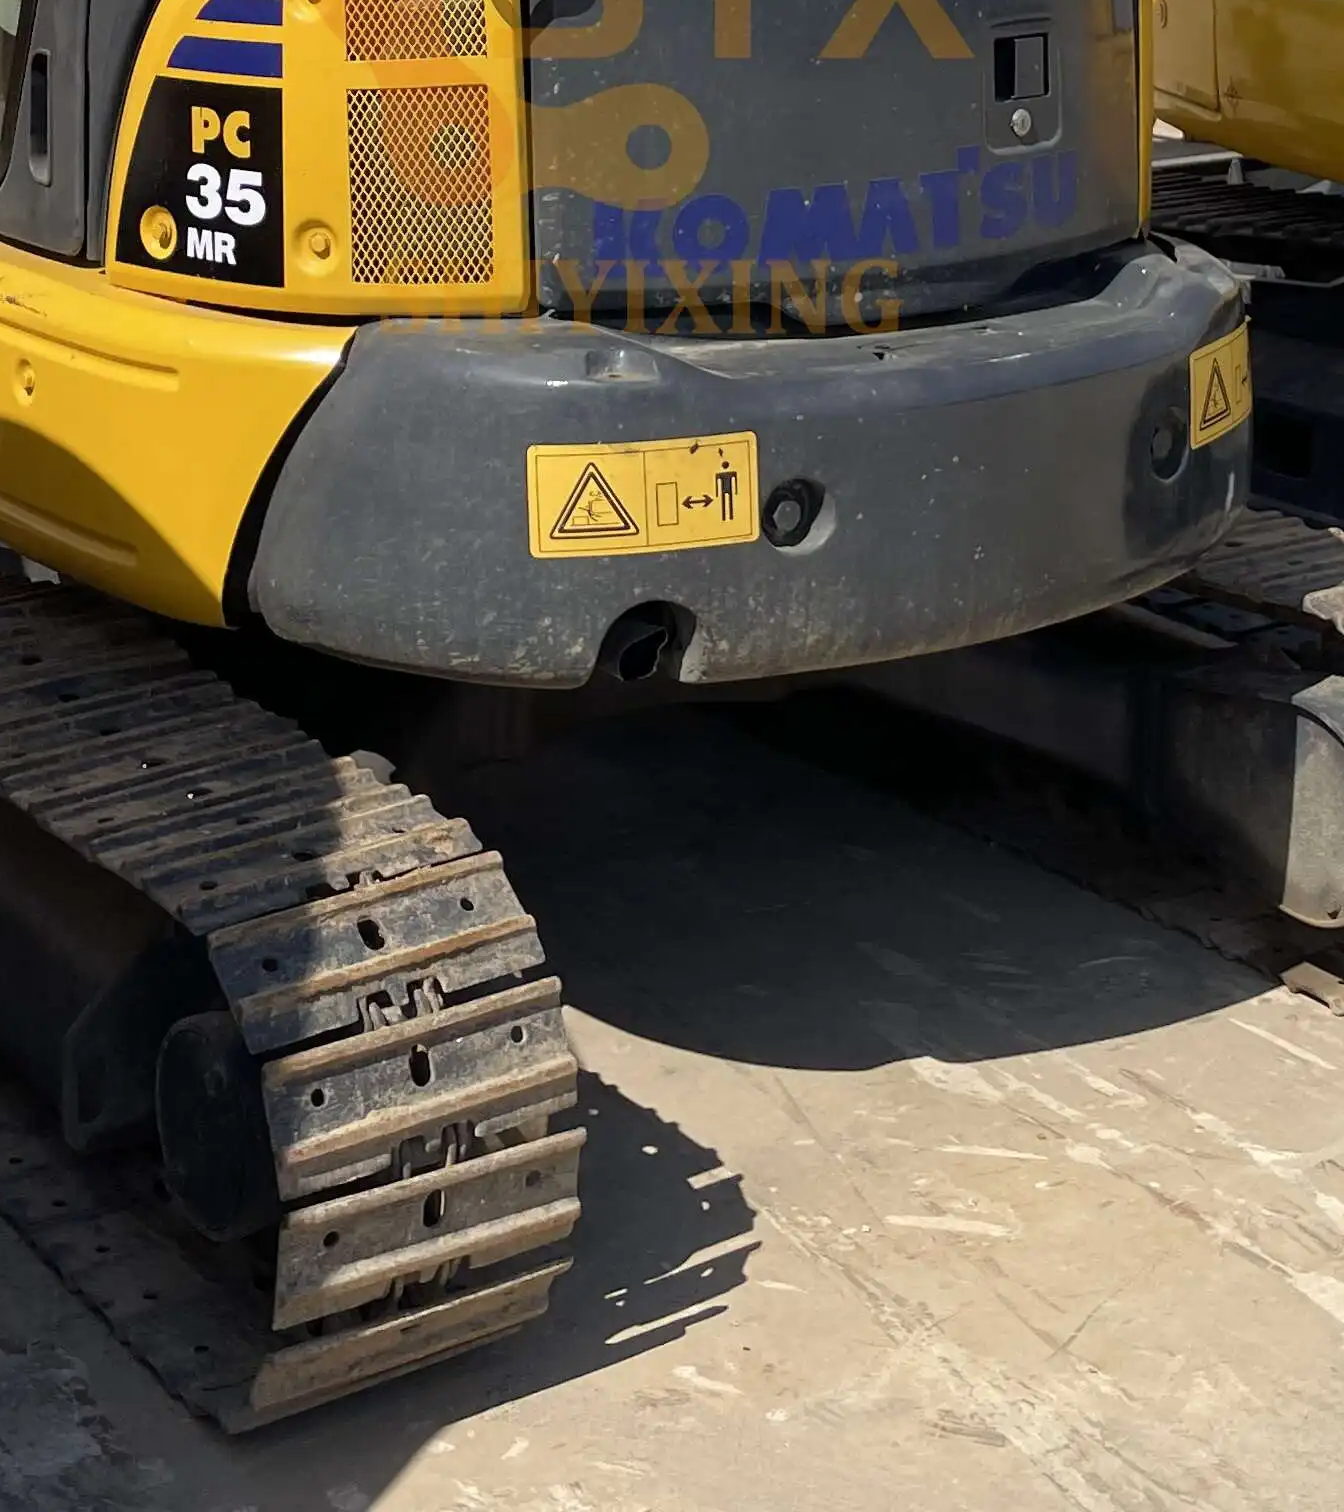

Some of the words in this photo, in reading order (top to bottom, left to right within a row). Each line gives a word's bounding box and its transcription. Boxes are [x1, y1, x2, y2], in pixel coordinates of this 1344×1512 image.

[191, 106, 252, 159] PC
[186, 163, 266, 226] 35
[591, 145, 1077, 278] KOMATSU
[186, 226, 238, 266] MR
